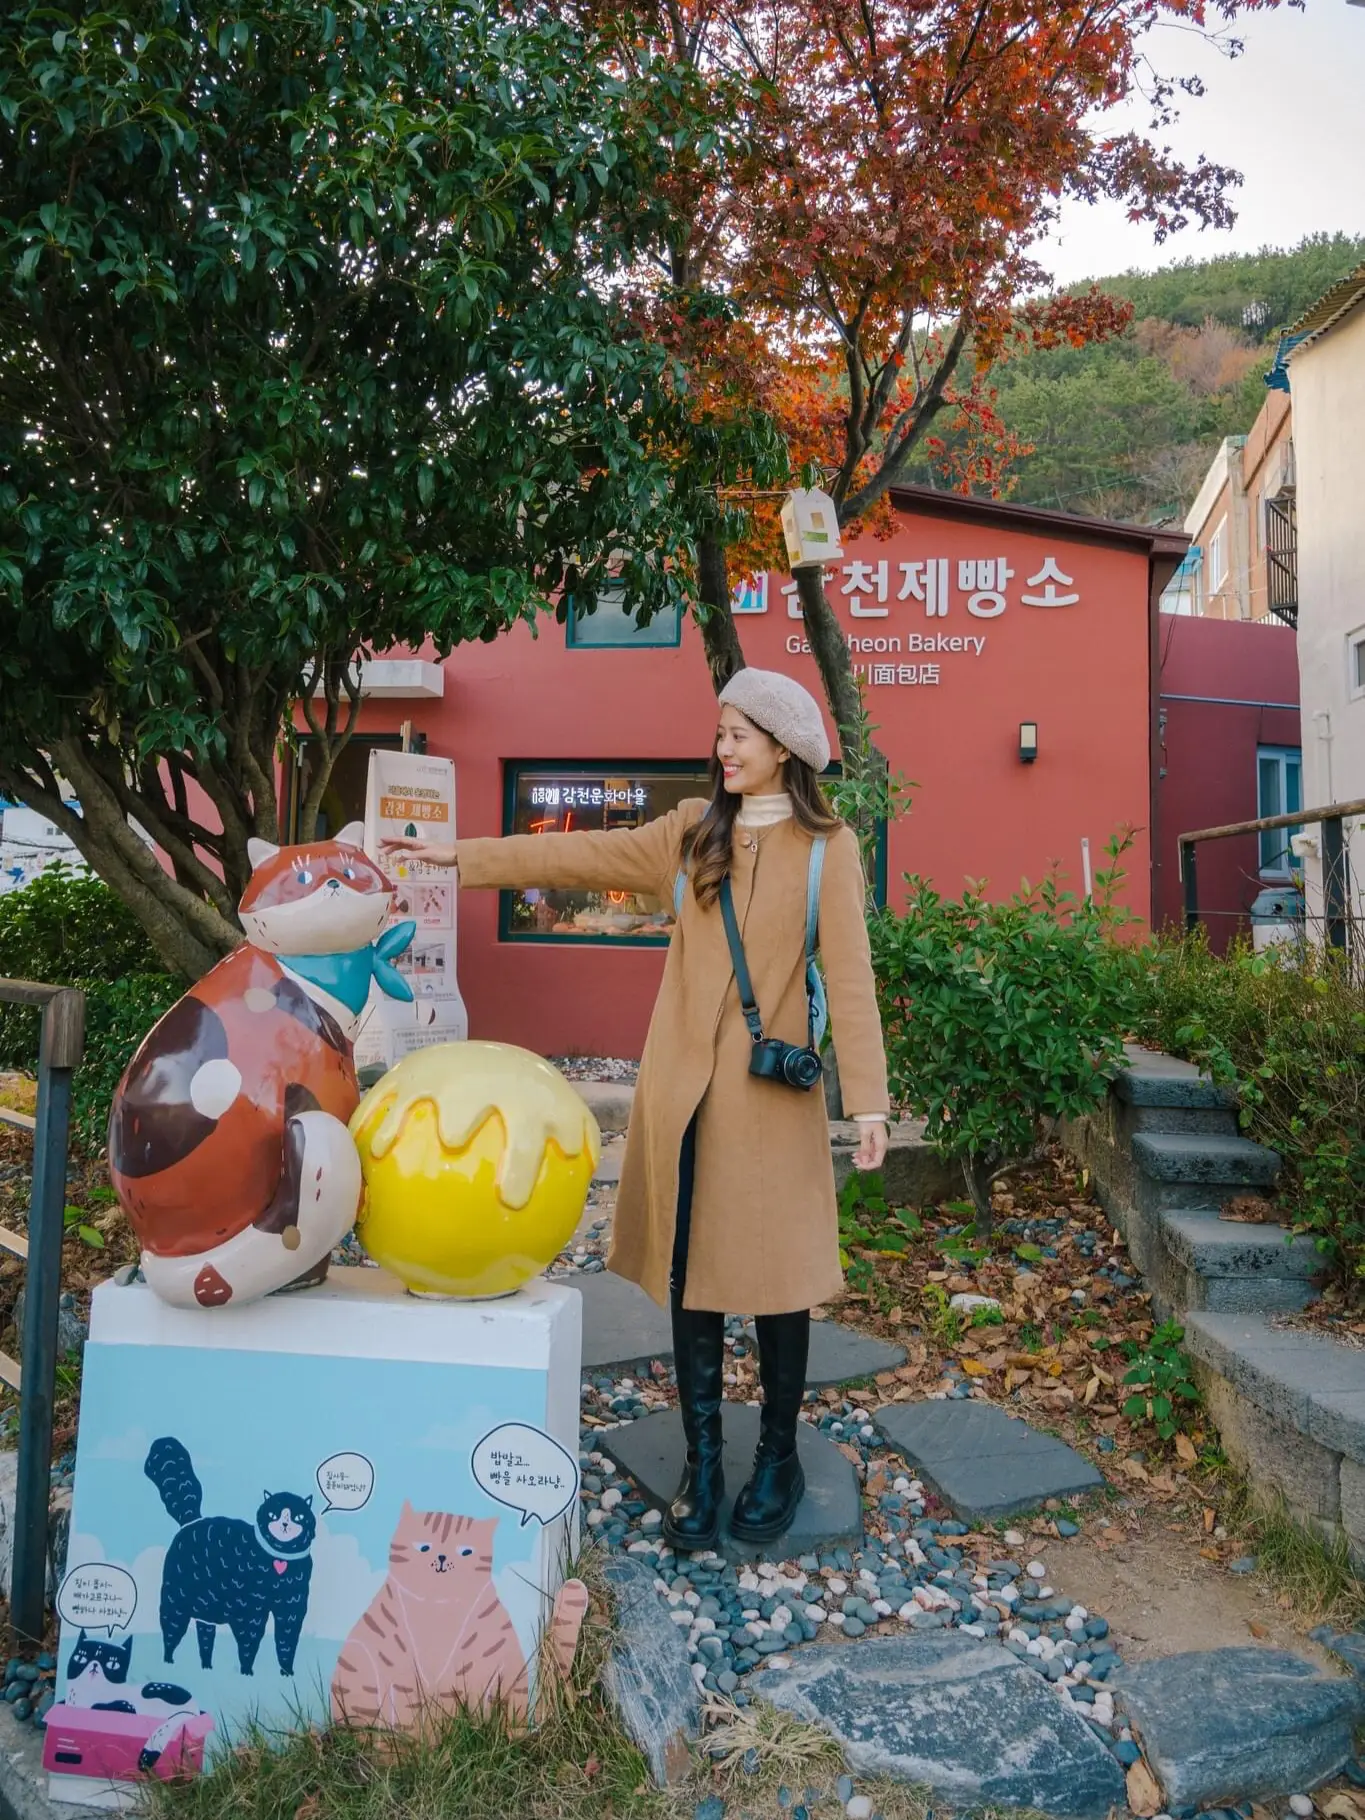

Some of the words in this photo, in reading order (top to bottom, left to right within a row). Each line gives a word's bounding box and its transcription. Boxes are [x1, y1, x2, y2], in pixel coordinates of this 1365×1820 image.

[786, 633, 901, 654] Gaheon
[908, 632, 986, 656] Bakery
[489, 1470, 511, 1487] 빵을
